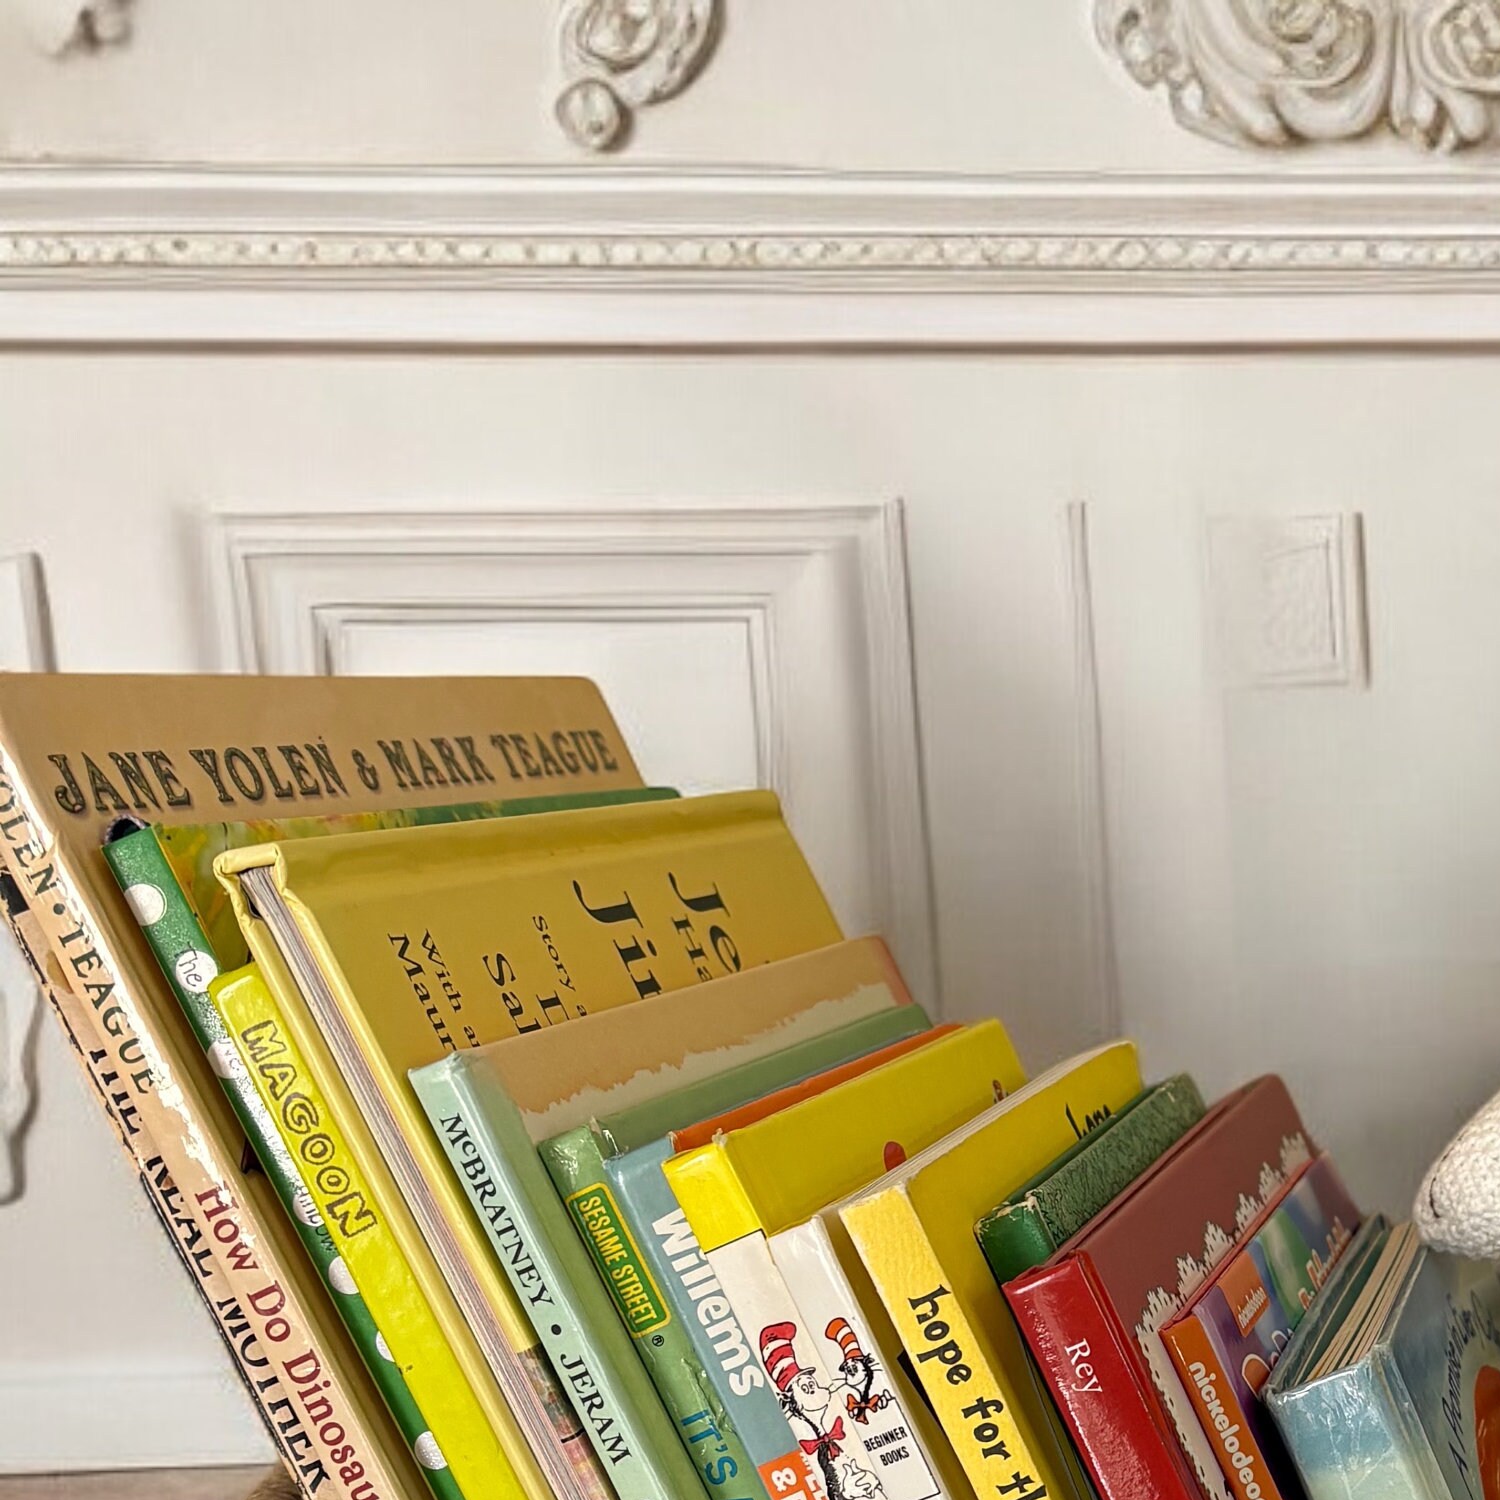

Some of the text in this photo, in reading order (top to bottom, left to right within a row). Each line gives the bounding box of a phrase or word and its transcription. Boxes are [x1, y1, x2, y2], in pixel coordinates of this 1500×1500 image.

[47, 730, 619, 814] JANE YOLEN & MARK TEAGUE
[0, 764, 57, 896] OLEN
[57, 921, 155, 1094] TEAGUE
[174, 942, 203, 988] The
[422, 928, 463, 1013] With
[532, 915, 575, 992] Story
[241, 1020, 378, 1239] MAGOON
[194, 1180, 259, 1272] How
[248, 1280, 291, 1342] Do
[579, 1196, 657, 1324] SESAME STREET
[652, 1208, 765, 1396] Willems
[908, 1284, 973, 1387] hope
[961, 1396, 1012, 1461] for
[1064, 1338, 1103, 1395] Rey
[560, 1353, 632, 1466] JERAM
[681, 1409, 739, 1486] IT'S
[864, 1426, 908, 1452] BEGINNER
[771, 1467, 797, 1492] &
[879, 1447, 910, 1466] BOOKS
